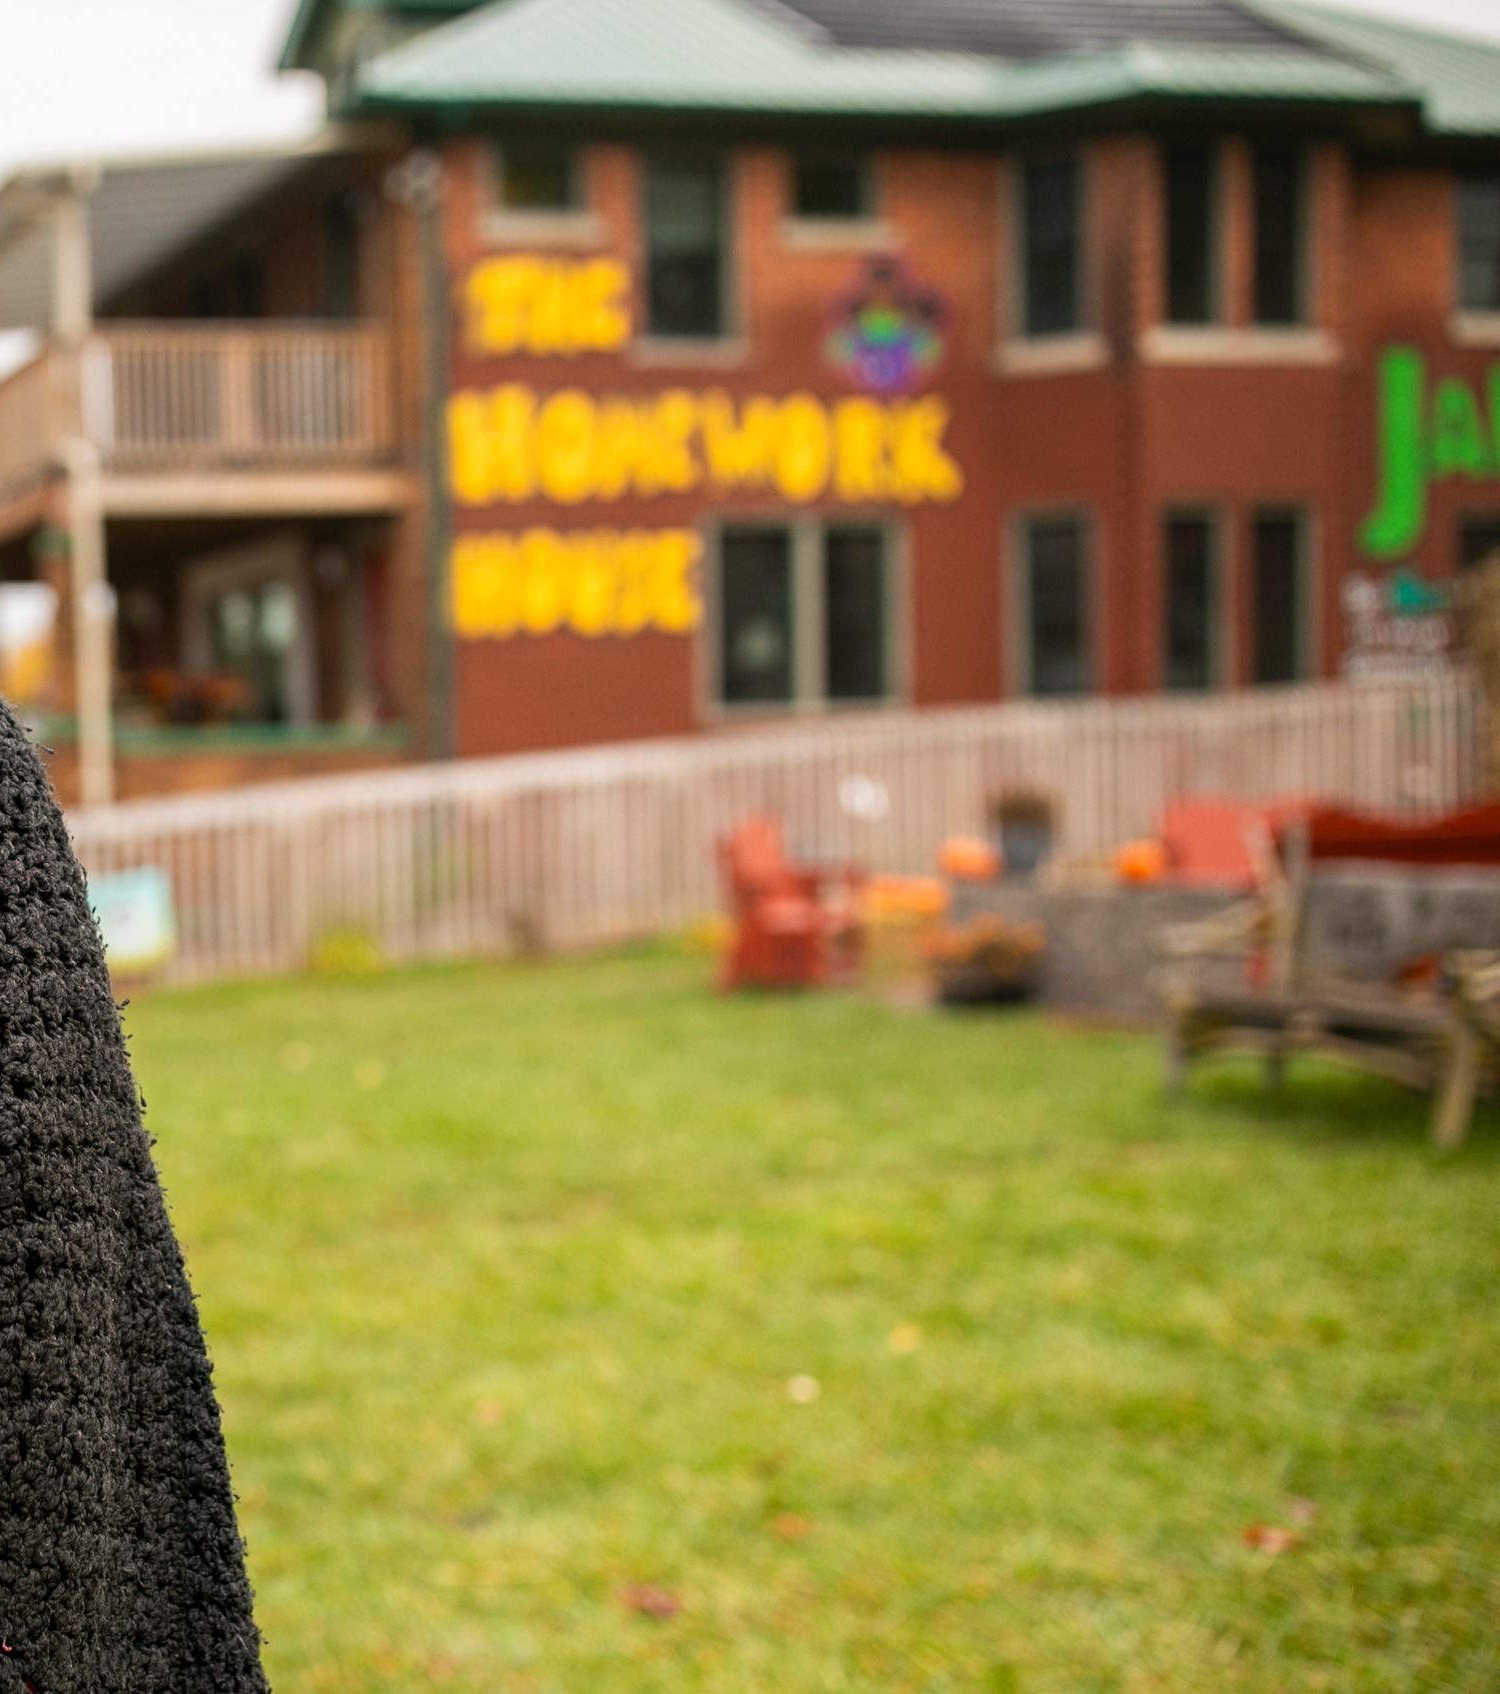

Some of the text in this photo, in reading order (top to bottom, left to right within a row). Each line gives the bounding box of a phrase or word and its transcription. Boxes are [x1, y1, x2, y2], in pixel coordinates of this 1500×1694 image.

[464, 253, 631, 354] THE
[446, 384, 963, 503] HOMEWORK
[1359, 347, 1500, 556] JA
[450, 529, 702, 637] HOUSE
